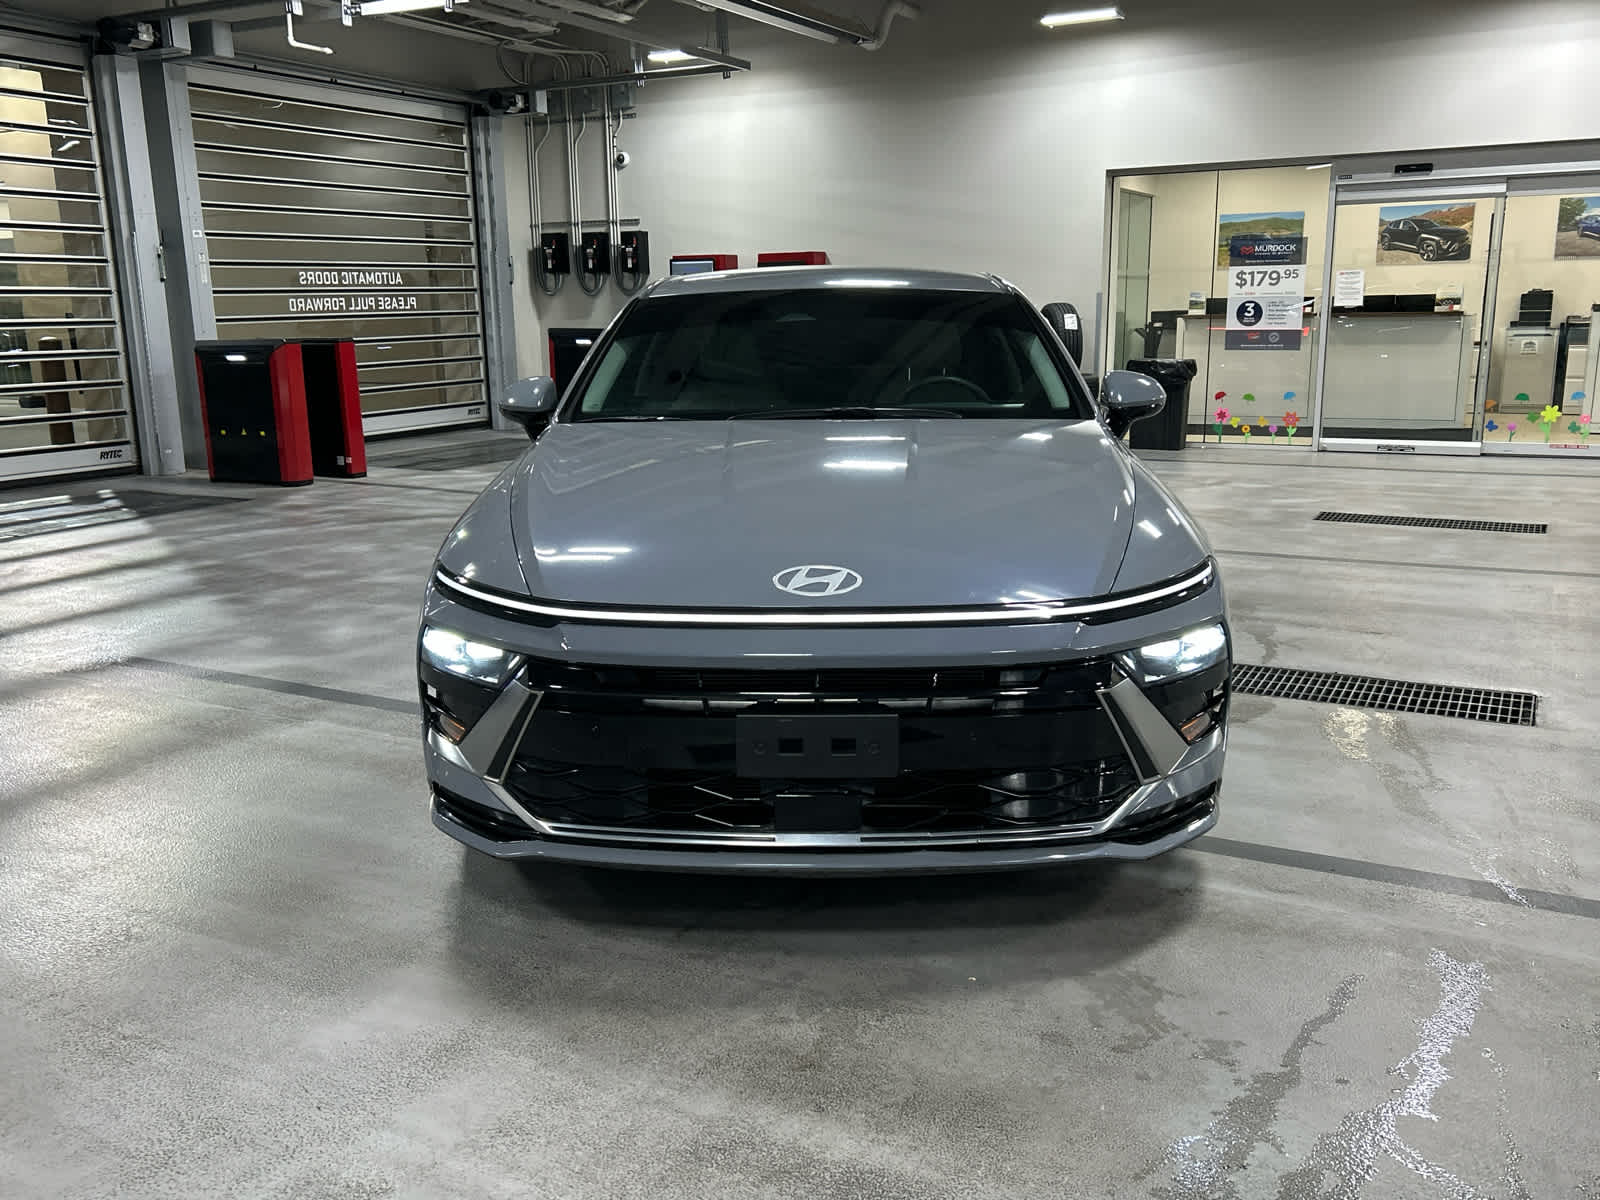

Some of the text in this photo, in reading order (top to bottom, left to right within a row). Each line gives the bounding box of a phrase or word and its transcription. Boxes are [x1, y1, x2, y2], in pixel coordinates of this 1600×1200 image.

[1255, 244, 1296, 252] MURDOCK
[1244, 303, 1255, 317] 3
[100, 449, 123, 460] RYTEC
